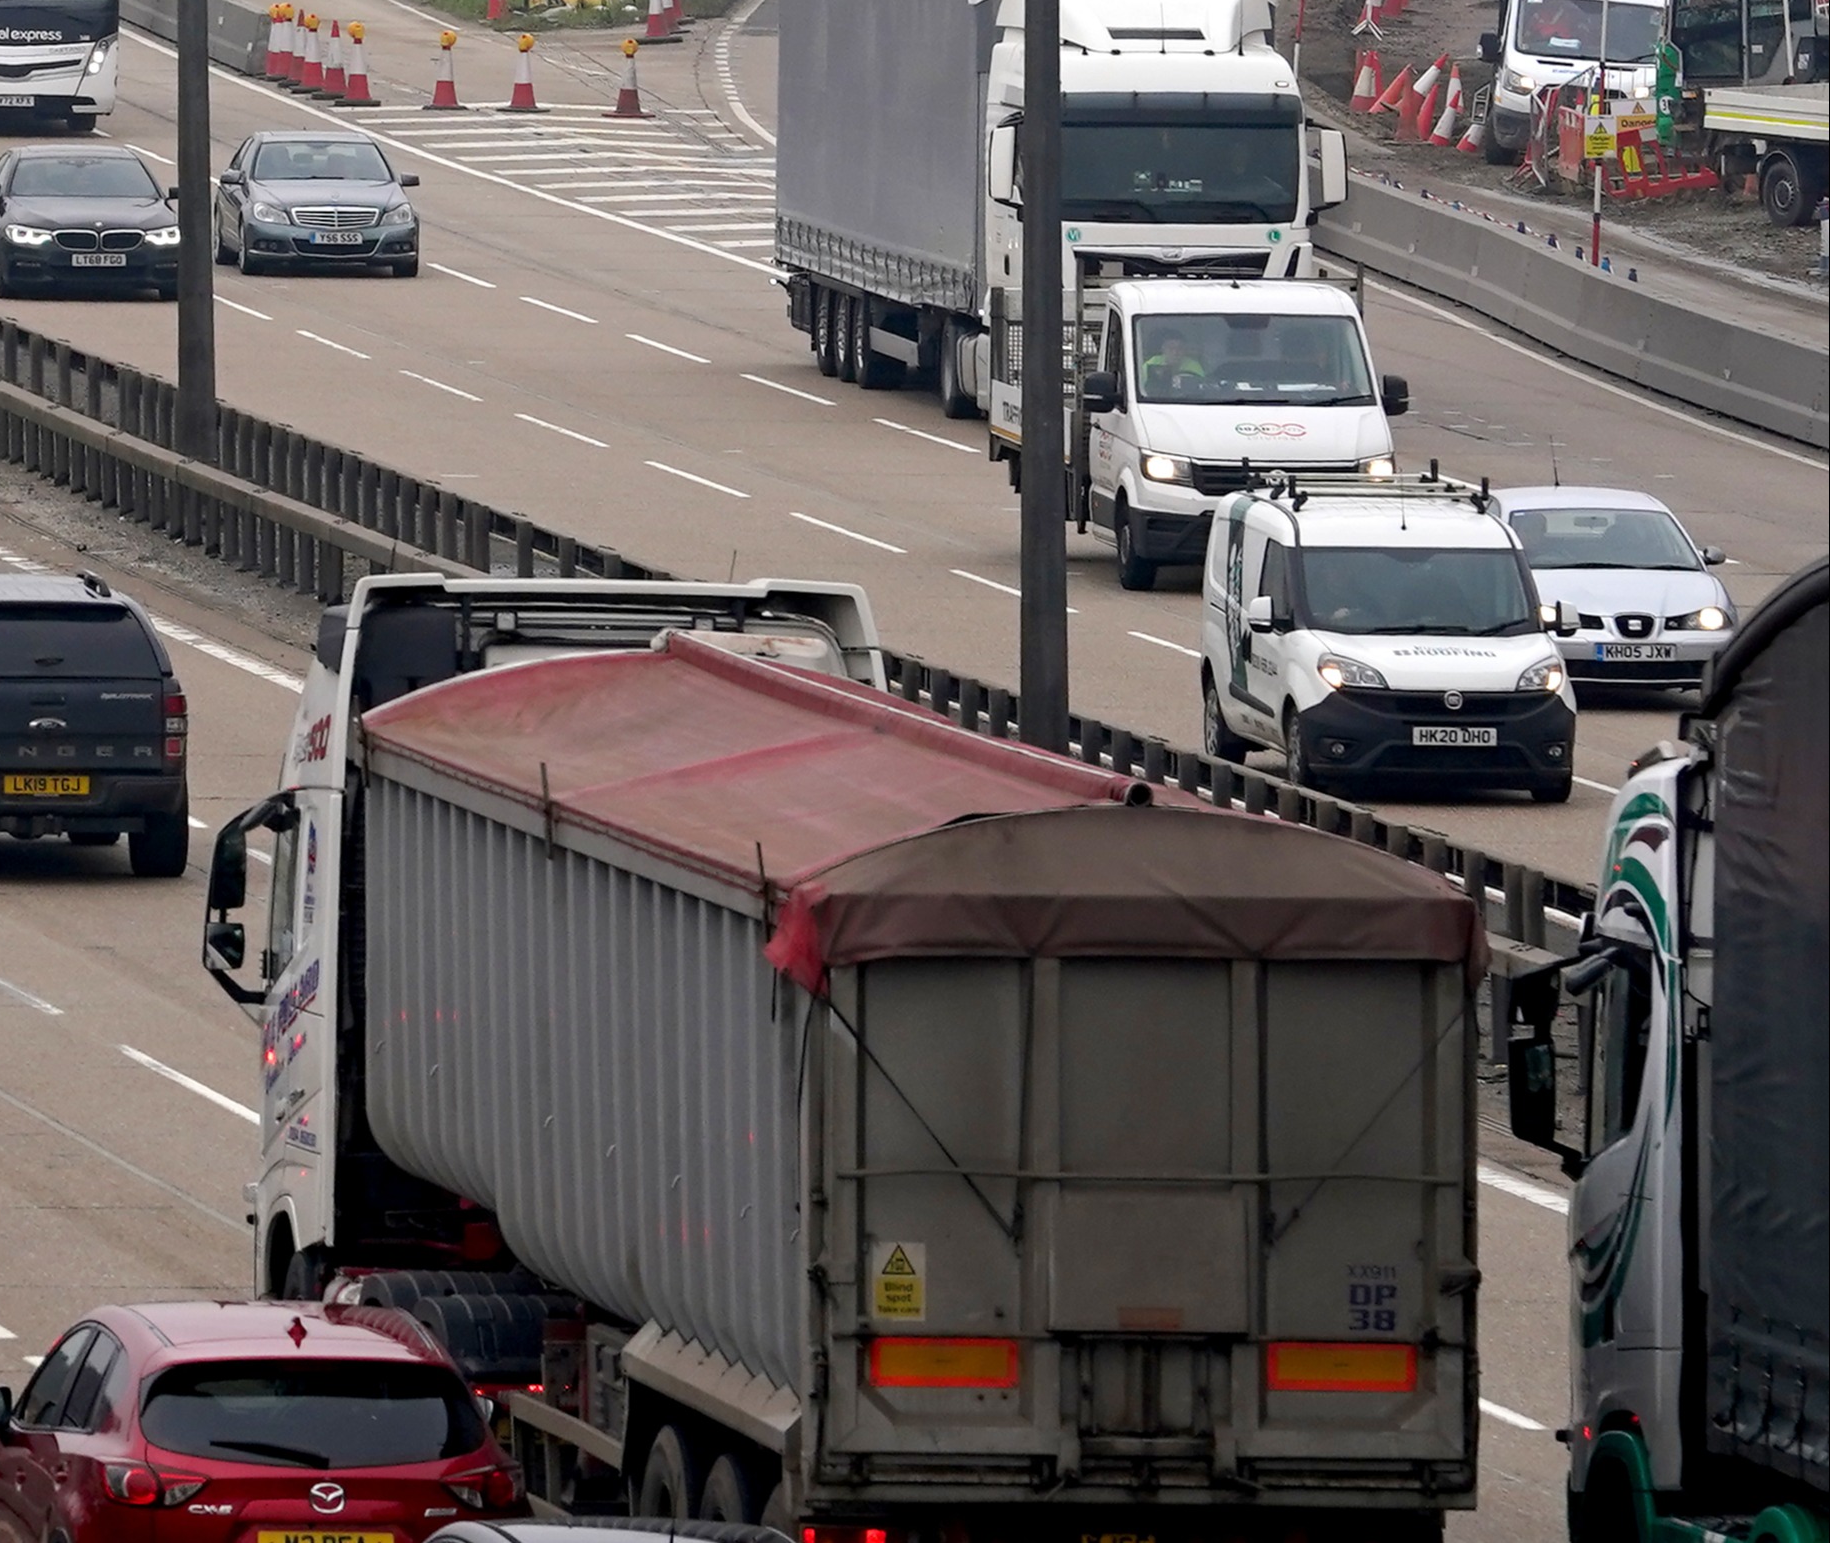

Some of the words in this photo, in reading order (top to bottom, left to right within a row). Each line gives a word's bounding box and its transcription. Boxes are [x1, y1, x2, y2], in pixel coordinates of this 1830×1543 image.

[10, 30, 63, 43] express
[76, 255, 101, 265] LT68
[1605, 645, 1642, 658] KH05
[1646, 645, 1672, 659] JXW
[1419, 729, 1458, 744] HK20
[1462, 729, 1491, 744] DHO
[13, 777, 48, 792] LK19
[52, 777, 81, 792] TGJ
[884, 1282, 914, 1292] Blind
[885, 1294, 912, 1304] spot
[1349, 1283, 1398, 1306] DP
[1348, 1308, 1396, 1331] 38
